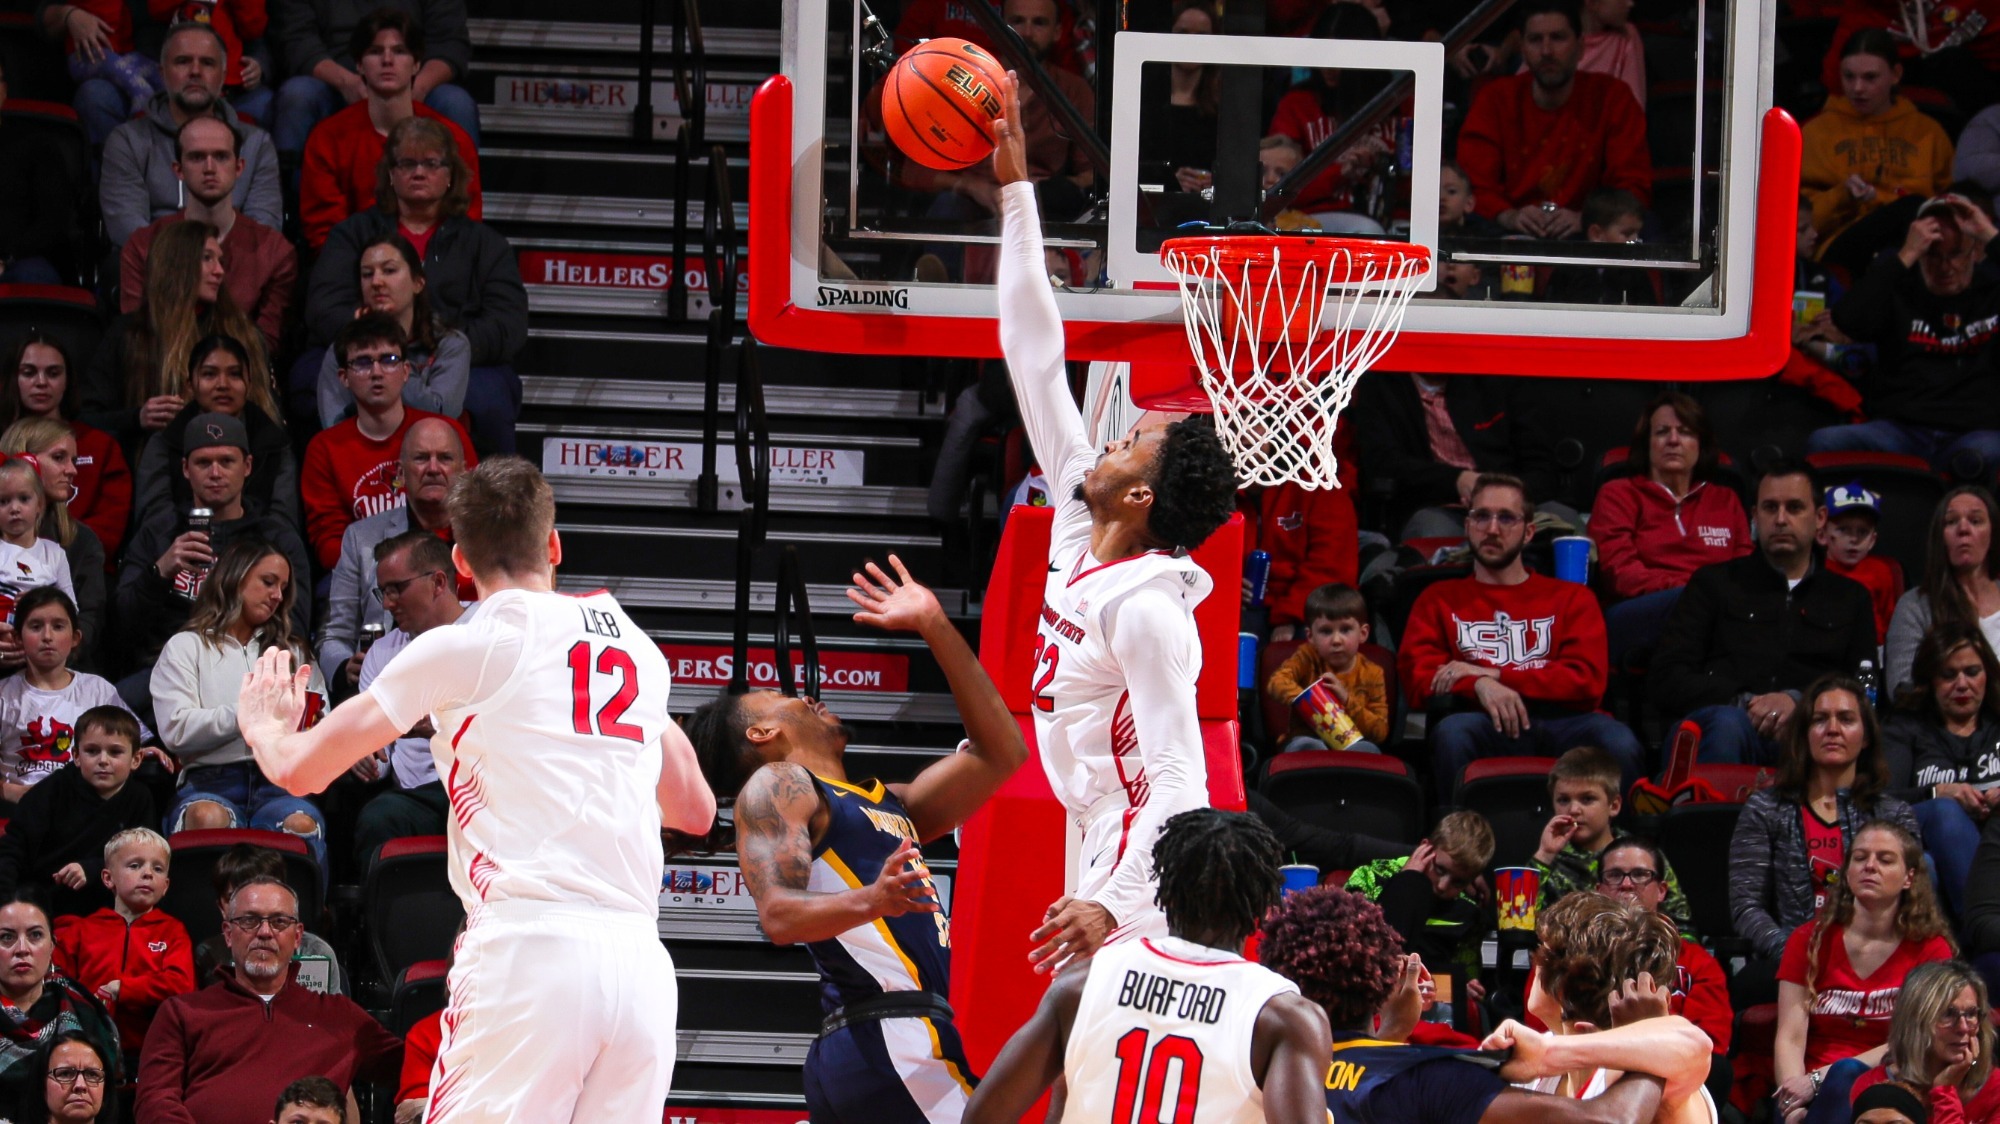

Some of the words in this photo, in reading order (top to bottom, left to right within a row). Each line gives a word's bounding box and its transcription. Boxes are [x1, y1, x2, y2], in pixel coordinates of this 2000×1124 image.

[510, 80, 627, 106] HELLER
[945, 64, 1002, 119] ELITE
[816, 285, 909, 310] SPALDING
[559, 442, 685, 471] HELLER
[589, 467, 657, 477] FORD
[577, 603, 621, 639] LIEB
[1055, 617, 1086, 646] STATE
[1451, 612, 1556, 667] ISU
[567, 640, 645, 745] 12
[672, 896, 725, 904] ORD
[1117, 969, 1226, 1025] BURFORD
[1111, 1026, 1204, 1124] 10
